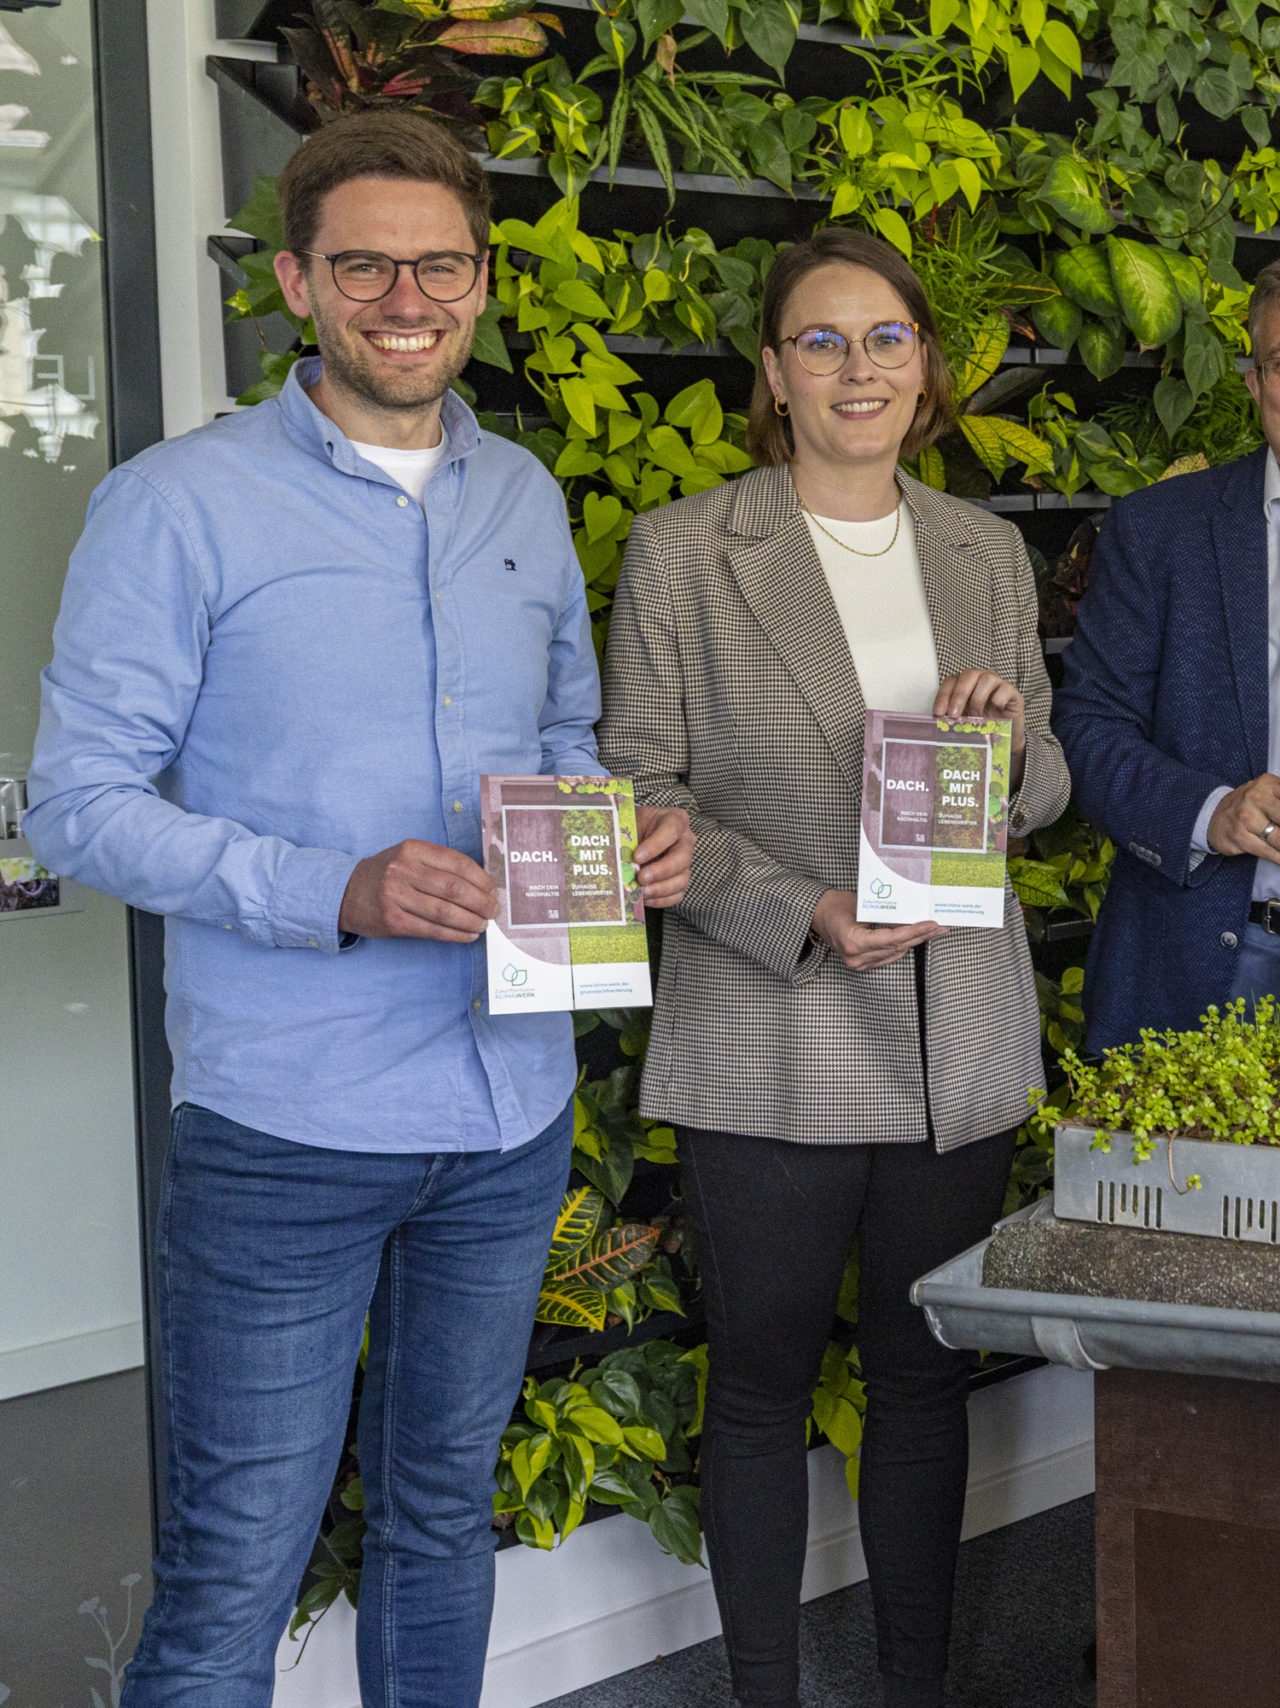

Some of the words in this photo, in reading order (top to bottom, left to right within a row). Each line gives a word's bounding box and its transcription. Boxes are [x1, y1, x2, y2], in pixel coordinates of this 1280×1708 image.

[943, 769, 980, 781] DACH
[886, 779, 929, 792] DACH.
[949, 783, 973, 794] MIT
[942, 796, 979, 807] PLUS.
[571, 836, 610, 846] DACH
[510, 851, 558, 863] DACH.
[580, 850, 604, 861] MIT
[573, 864, 612, 876] PLUS.
